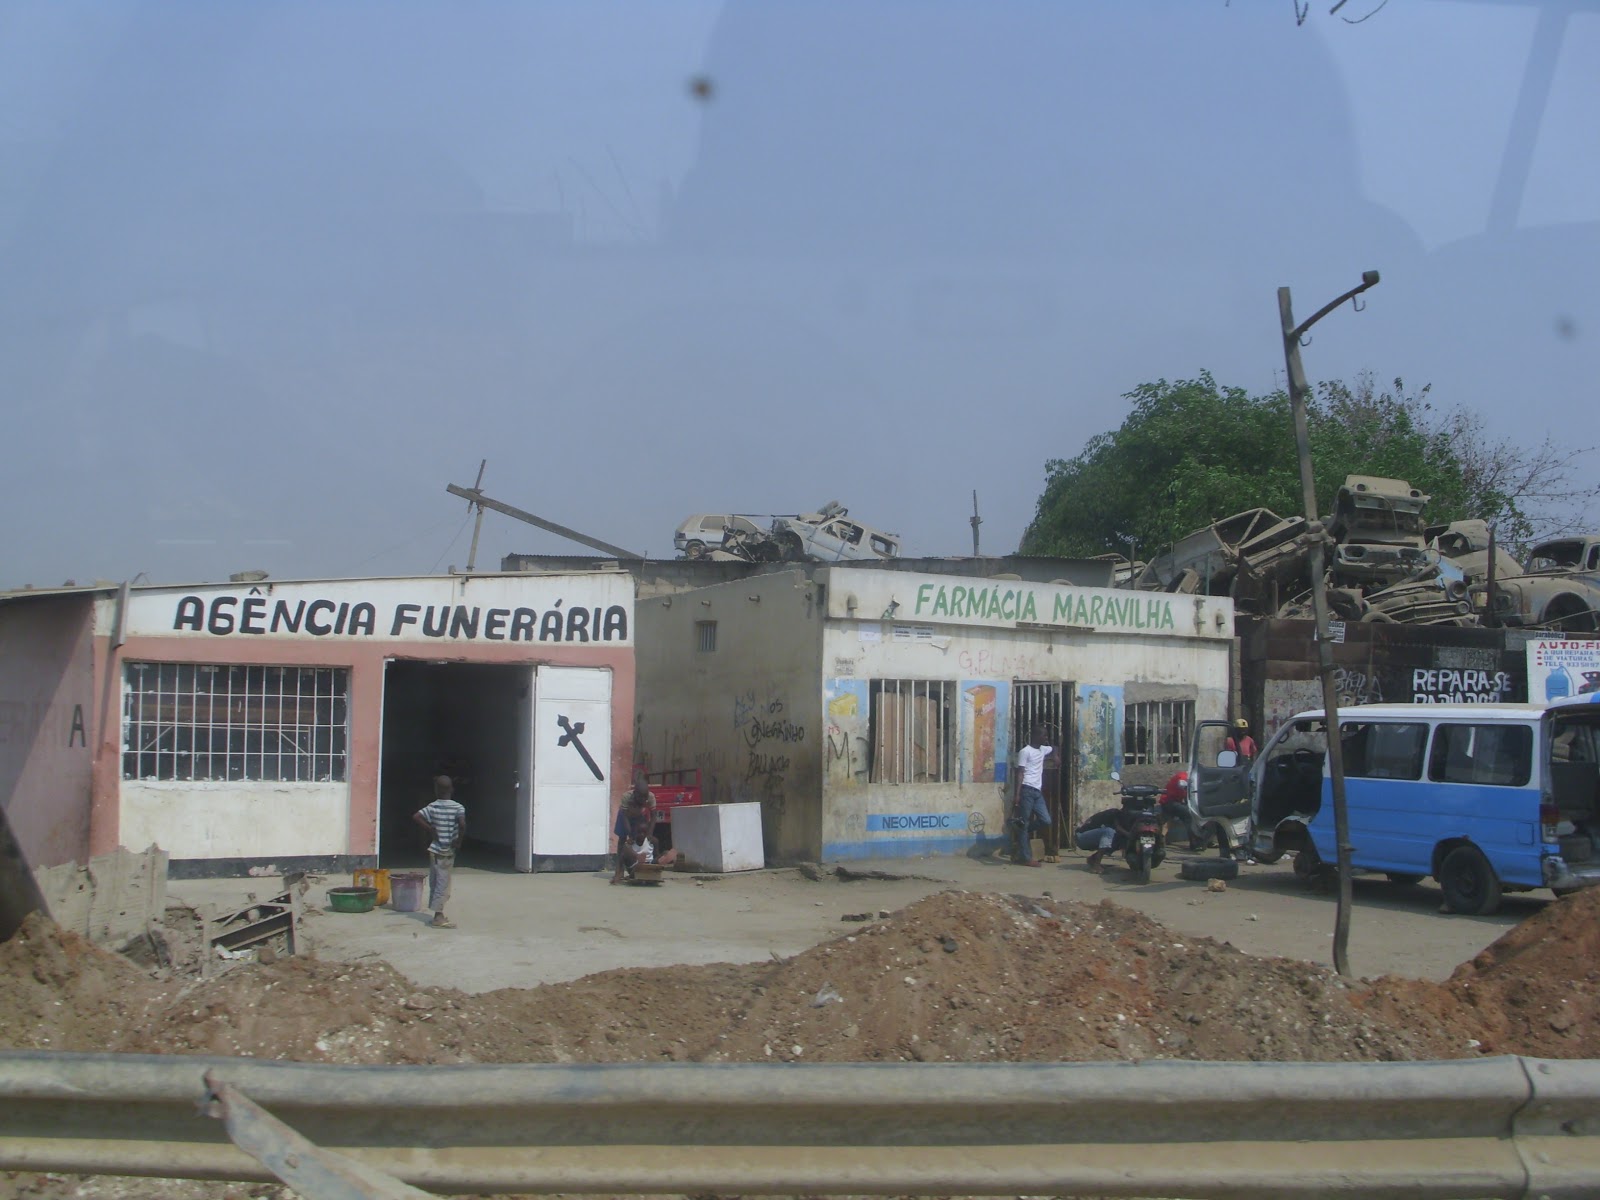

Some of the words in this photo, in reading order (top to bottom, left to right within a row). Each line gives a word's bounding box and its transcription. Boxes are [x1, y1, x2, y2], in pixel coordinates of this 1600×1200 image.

[173, 586, 376, 636] AGÊNCIA
[389, 598, 628, 642] FUNERÁRIA
[914, 584, 1038, 622] FARMÁCIA
[1053, 592, 1175, 630] MARAVILHA
[1413, 668, 1512, 692] REPARA-SE
[882, 815, 950, 829] NEOMEDIC
